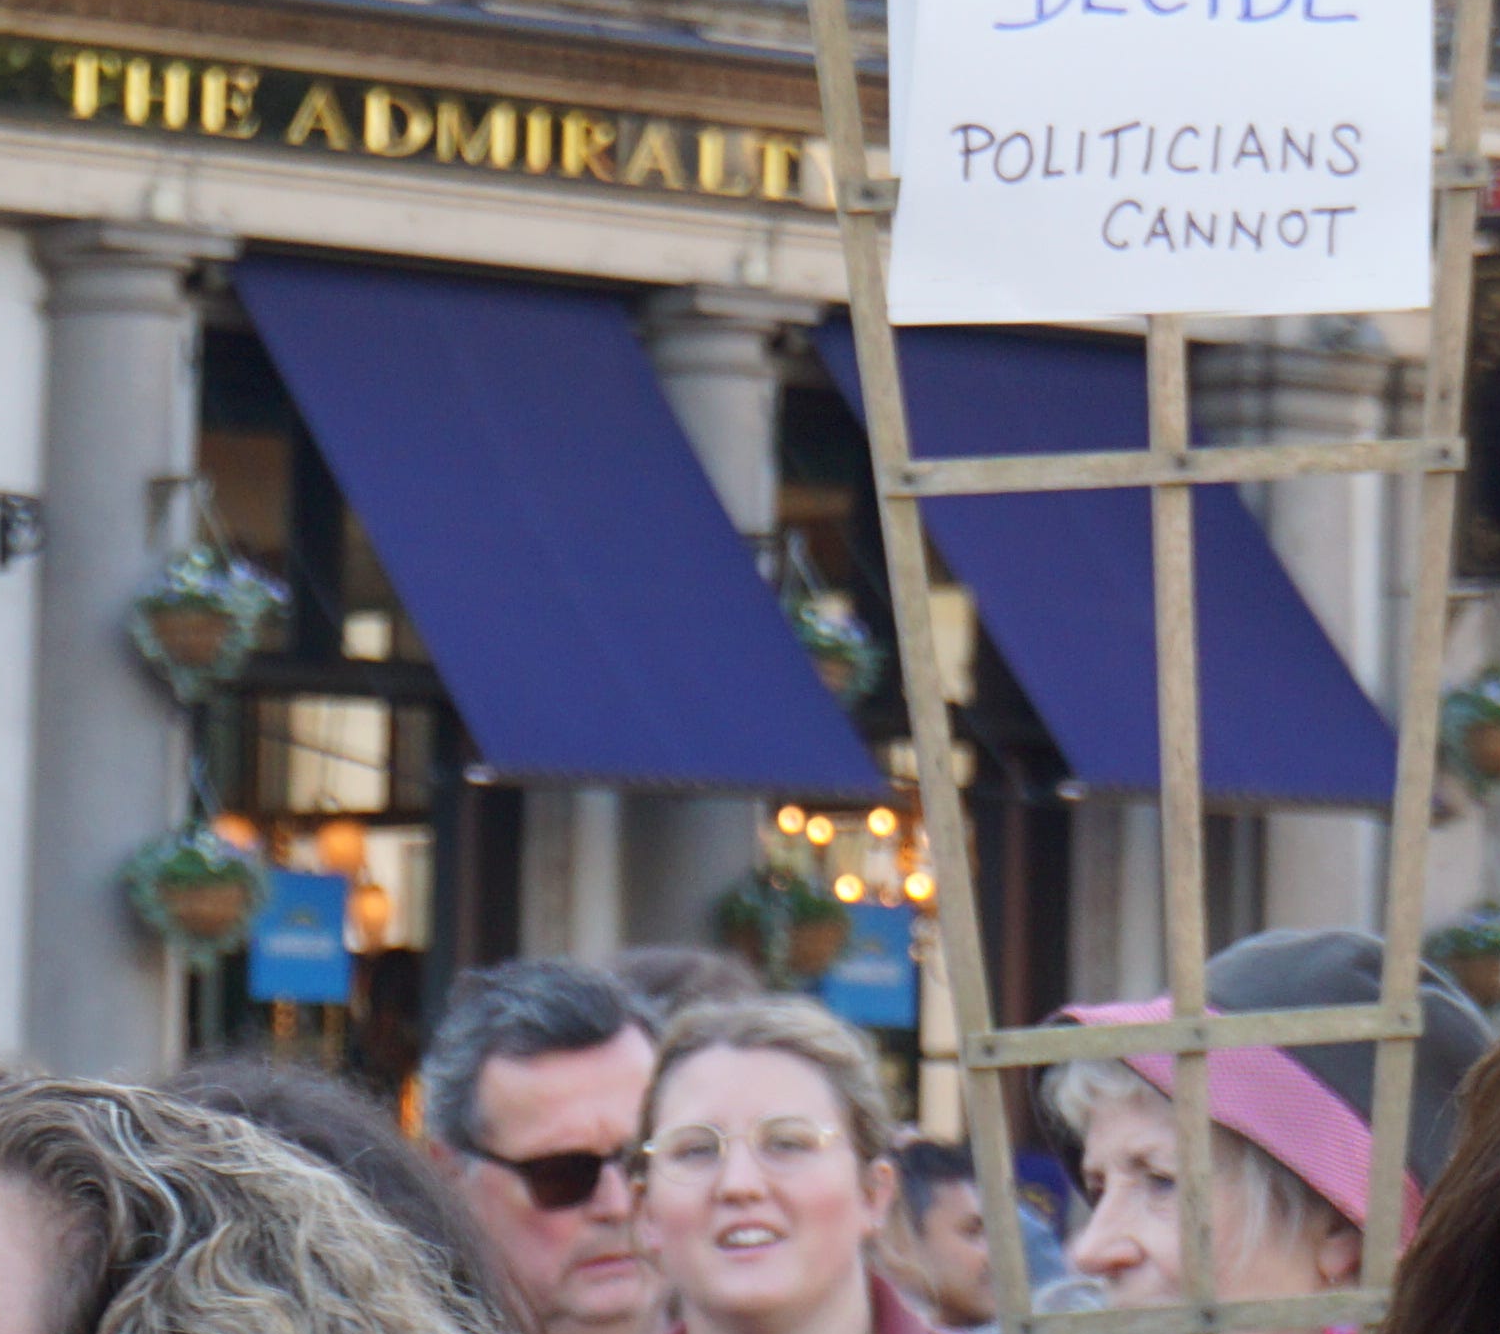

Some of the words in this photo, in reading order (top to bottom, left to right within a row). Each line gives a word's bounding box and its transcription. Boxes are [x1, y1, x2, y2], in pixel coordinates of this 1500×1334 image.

[62, 51, 260, 139] THE
[951, 121, 1363, 183] POLITICIANS
[1101, 199, 1357, 256] CANNOT
